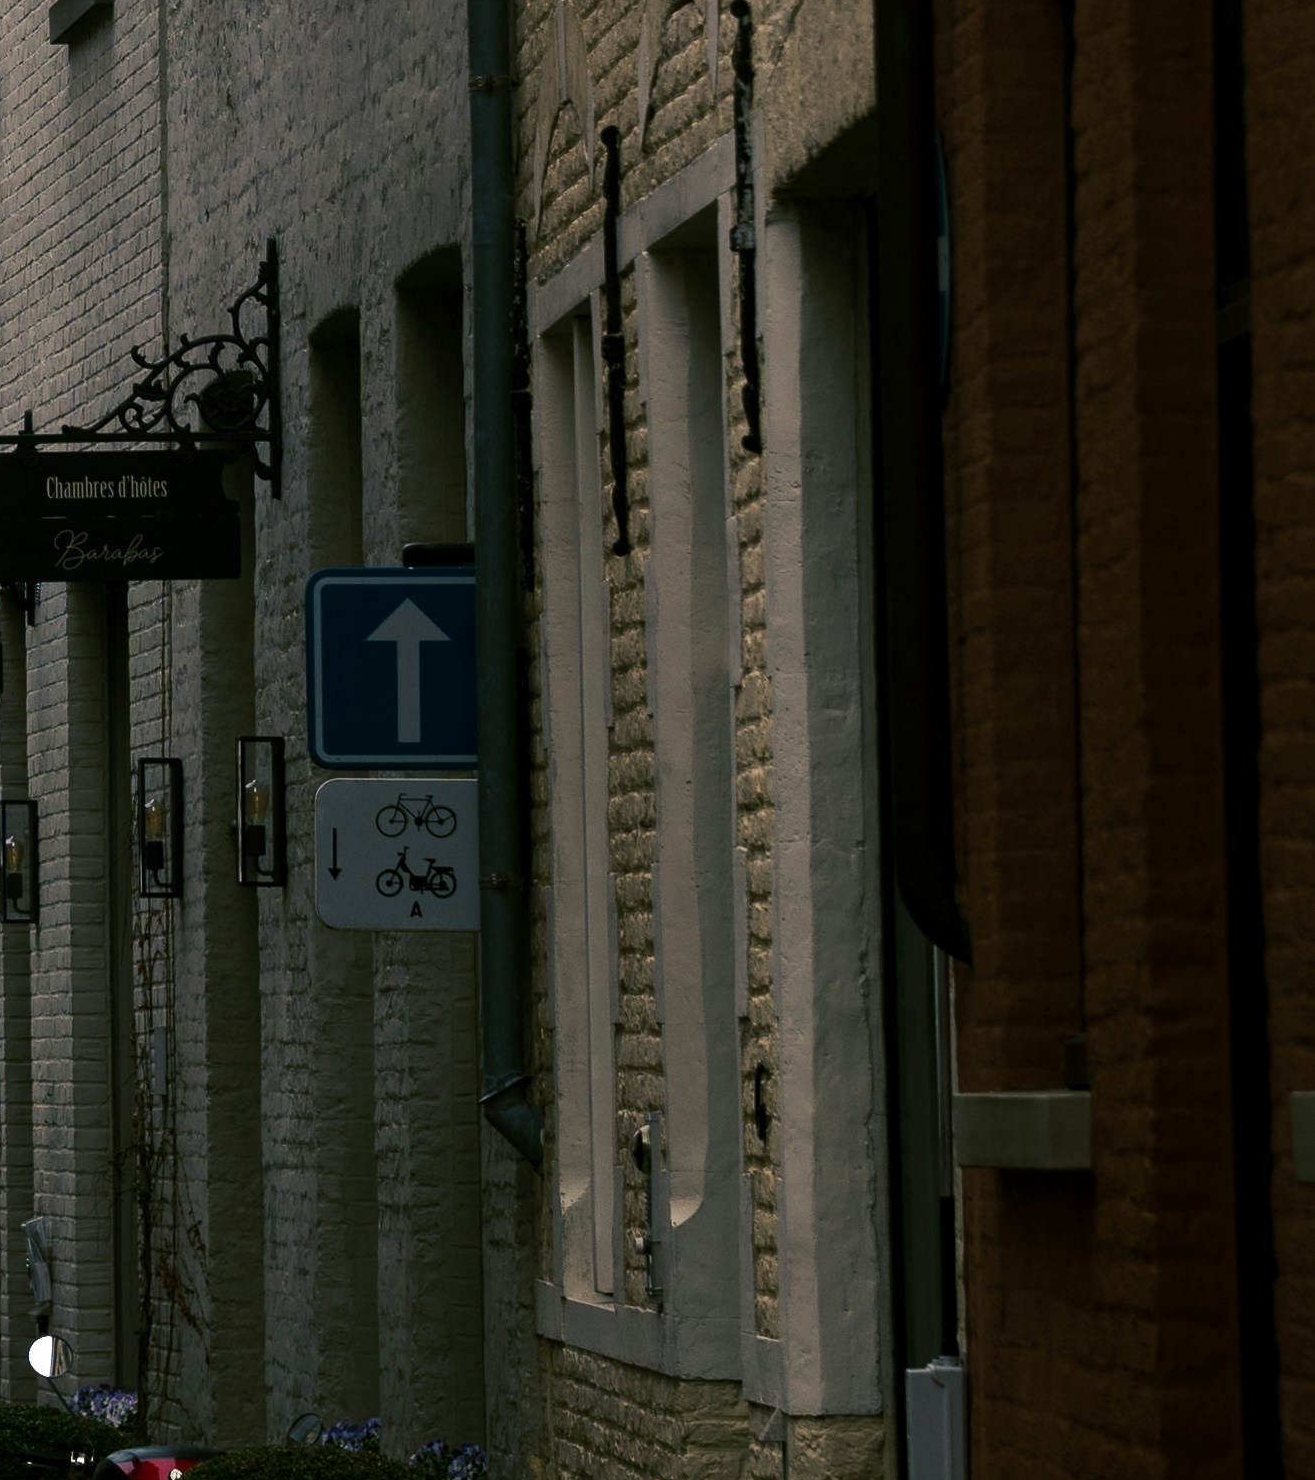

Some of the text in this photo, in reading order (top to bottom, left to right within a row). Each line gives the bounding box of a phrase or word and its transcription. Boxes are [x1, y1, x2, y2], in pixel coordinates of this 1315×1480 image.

[45, 475, 168, 499] Chambres d'hôtes
[53, 529, 165, 571] Barabas
[410, 901, 423, 918] A
